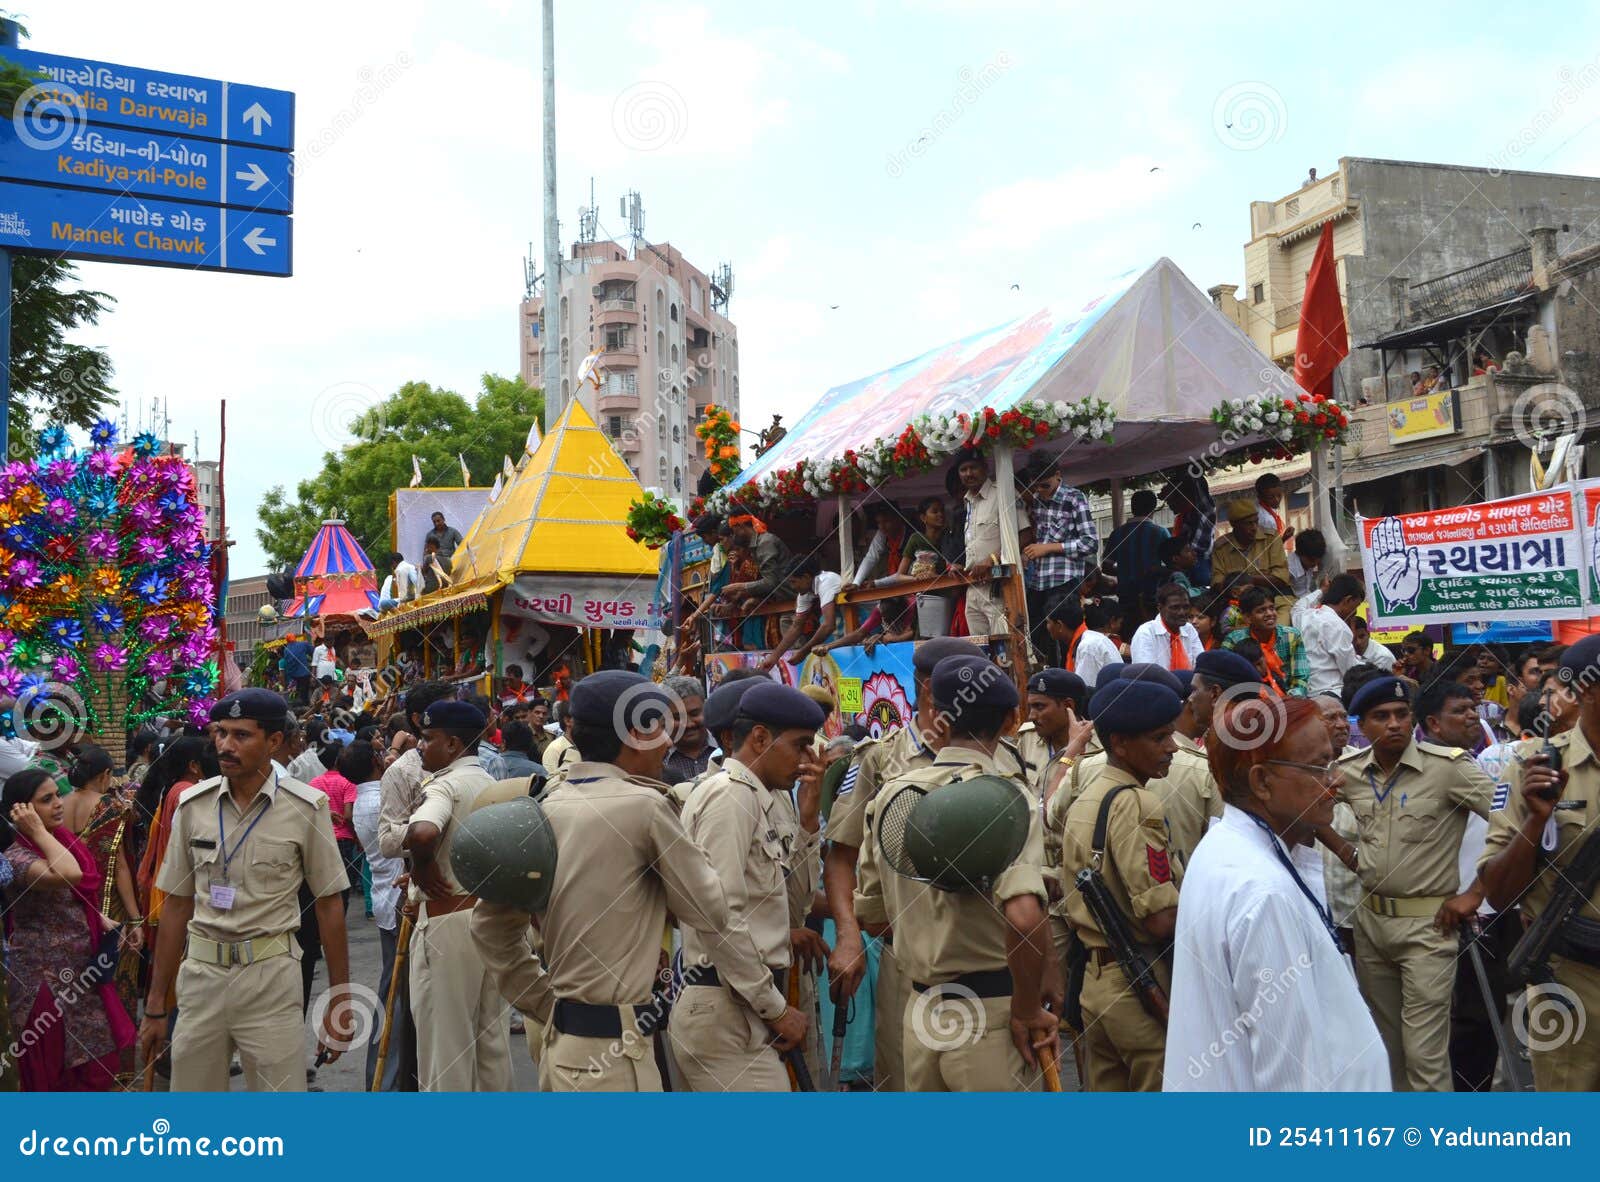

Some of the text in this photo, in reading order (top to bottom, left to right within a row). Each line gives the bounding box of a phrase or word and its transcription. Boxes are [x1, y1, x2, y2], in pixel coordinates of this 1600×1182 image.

[119, 97, 208, 129] Darwaja
[57, 155, 207, 190] Kadiya-ni-Pole
[51, 220, 207, 255] Manek Chawk
[170, 210, 207, 232] ચોક
[1428, 537, 1566, 575] રથયાત્રા
